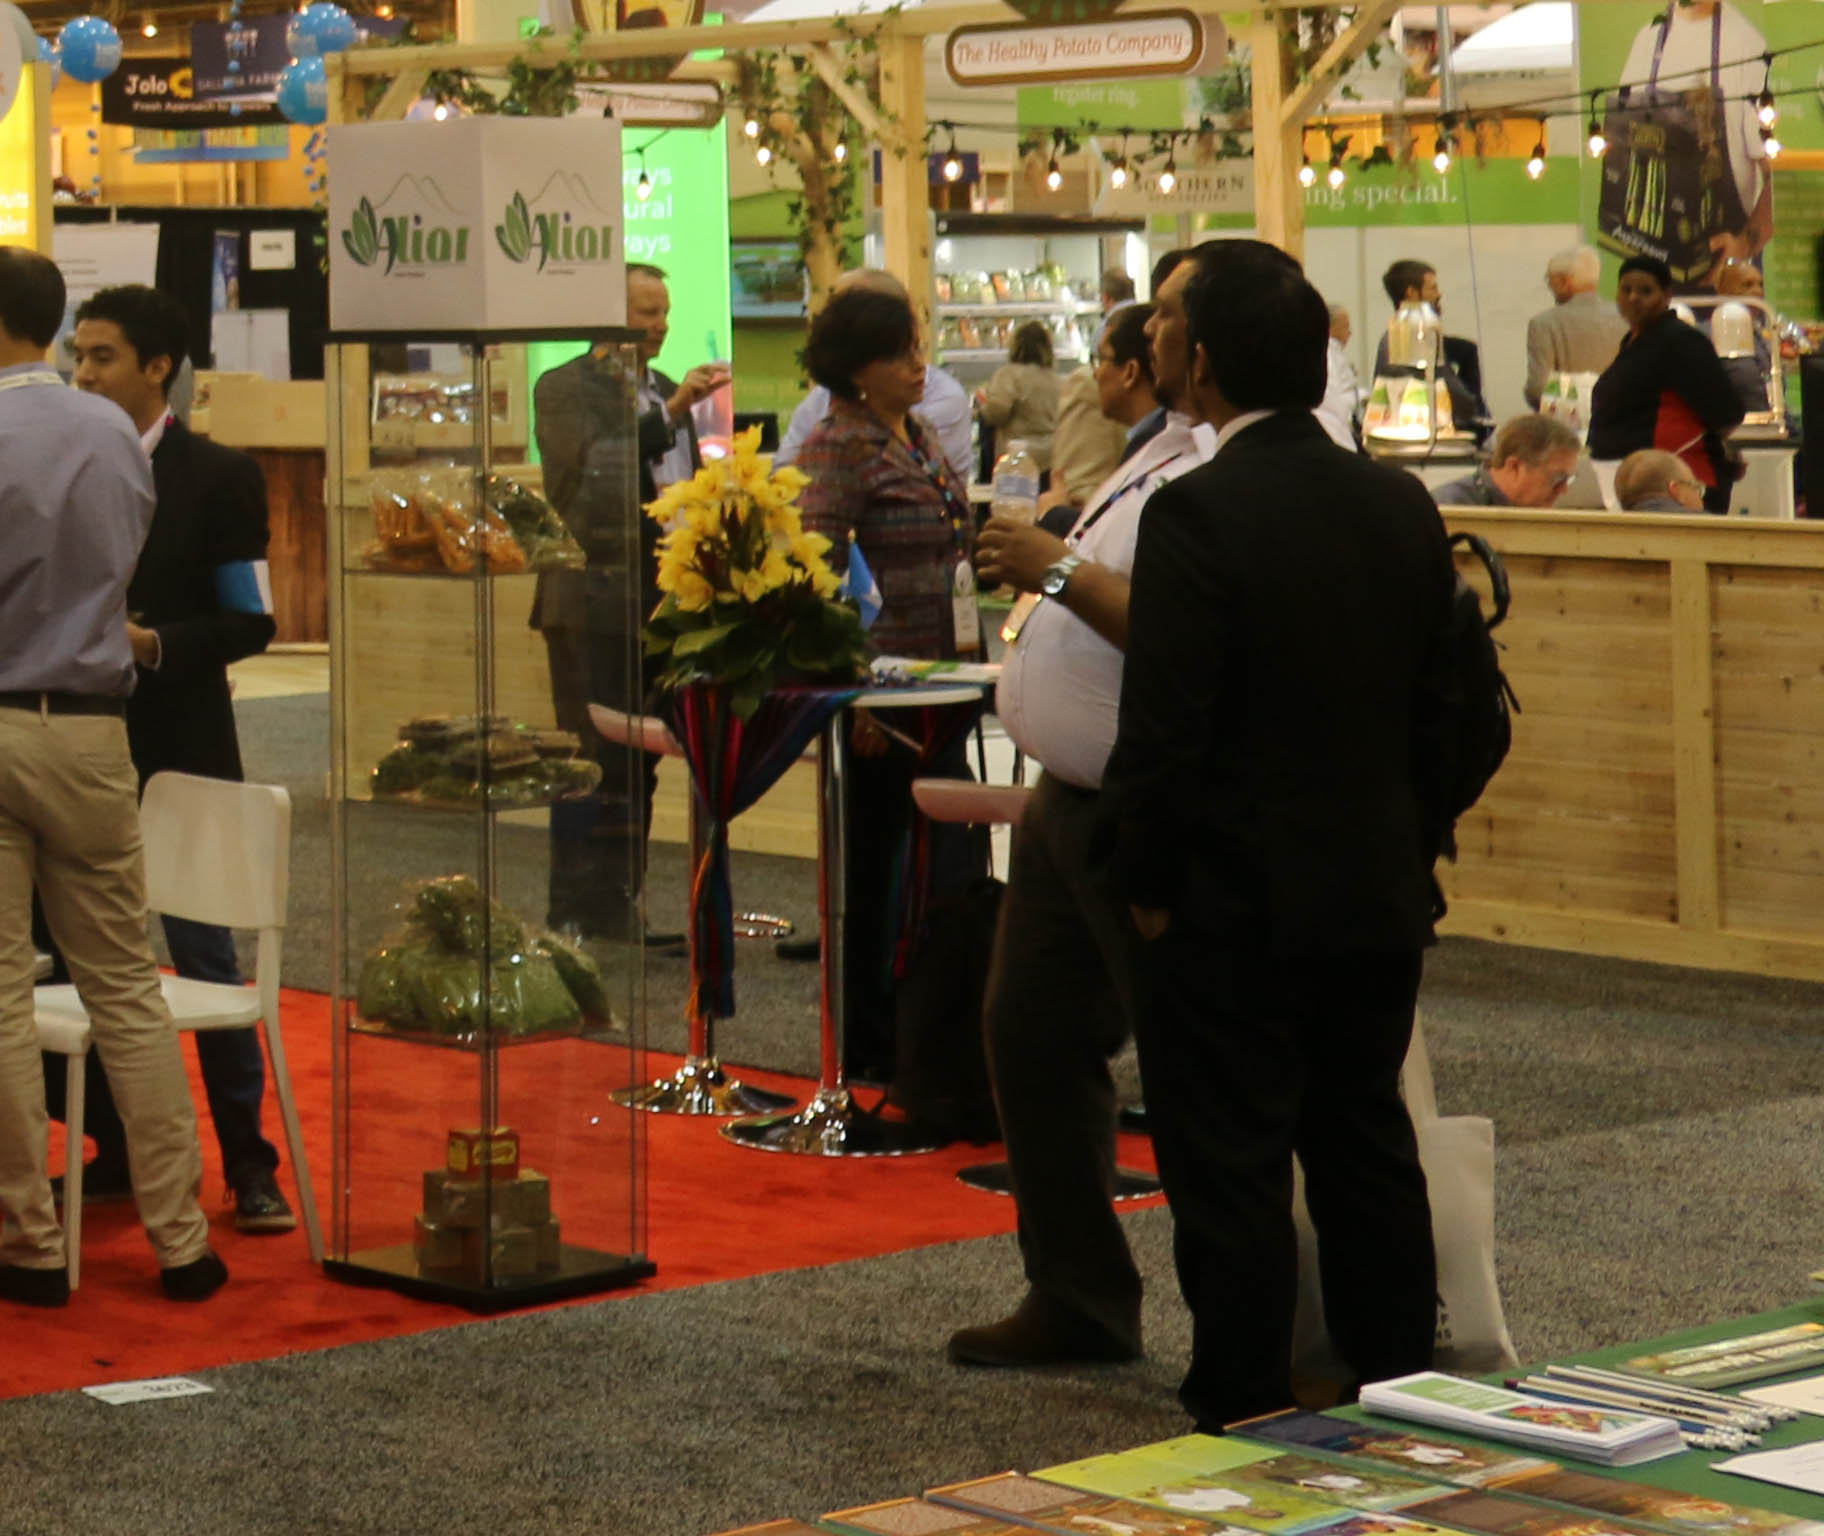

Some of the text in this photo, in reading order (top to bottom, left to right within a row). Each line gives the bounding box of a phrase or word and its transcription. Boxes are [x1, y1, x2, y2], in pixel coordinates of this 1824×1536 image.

[956, 29, 1184, 65] The Healthy Potato Company
[623, 192, 673, 220] ural
[1304, 181, 1458, 210] ing special.
